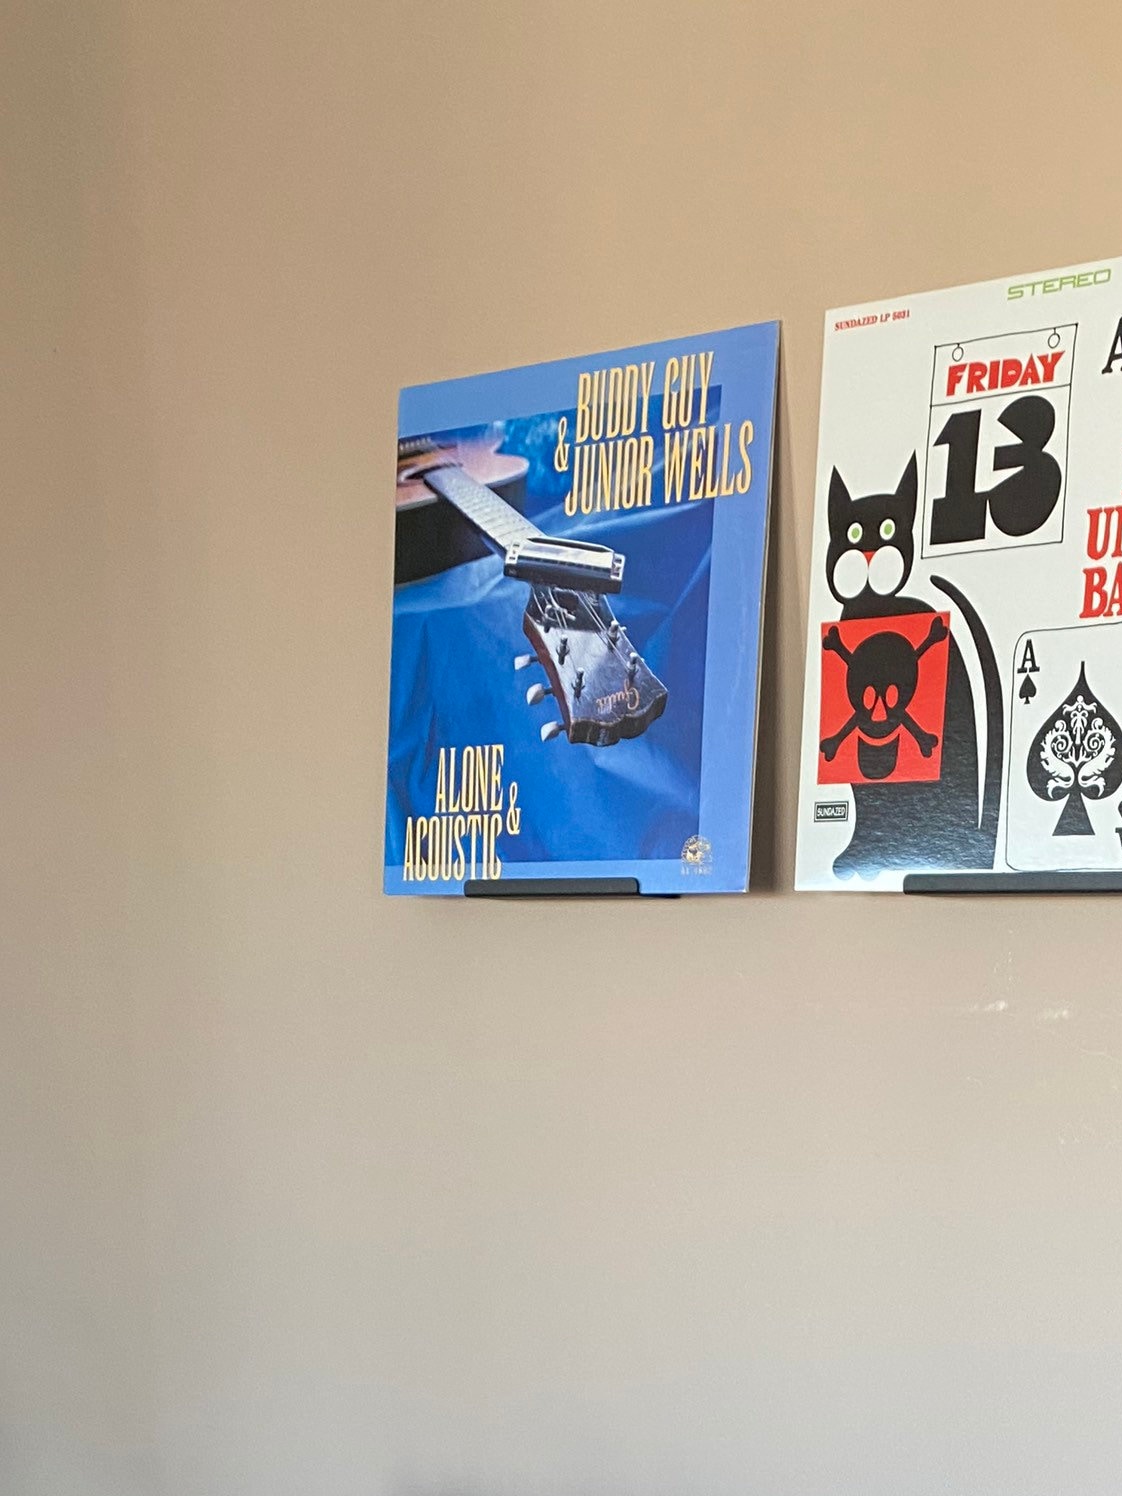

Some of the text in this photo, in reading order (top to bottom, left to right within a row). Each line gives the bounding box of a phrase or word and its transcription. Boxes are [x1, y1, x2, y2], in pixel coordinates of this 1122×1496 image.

[1007, 269, 1111, 300] STEREO
[880, 313, 891, 323] LP
[575, 351, 714, 444] BUDDY GUY
[946, 350, 1066, 397] FRIDAY
[554, 416, 754, 517] & JUNIOR WELLS
[930, 395, 1062, 546] 13
[1017, 639, 1040, 674] A
[435, 744, 504, 813] ALONE
[506, 781, 521, 835] &
[403, 813, 503, 881] ACOUSTIC
